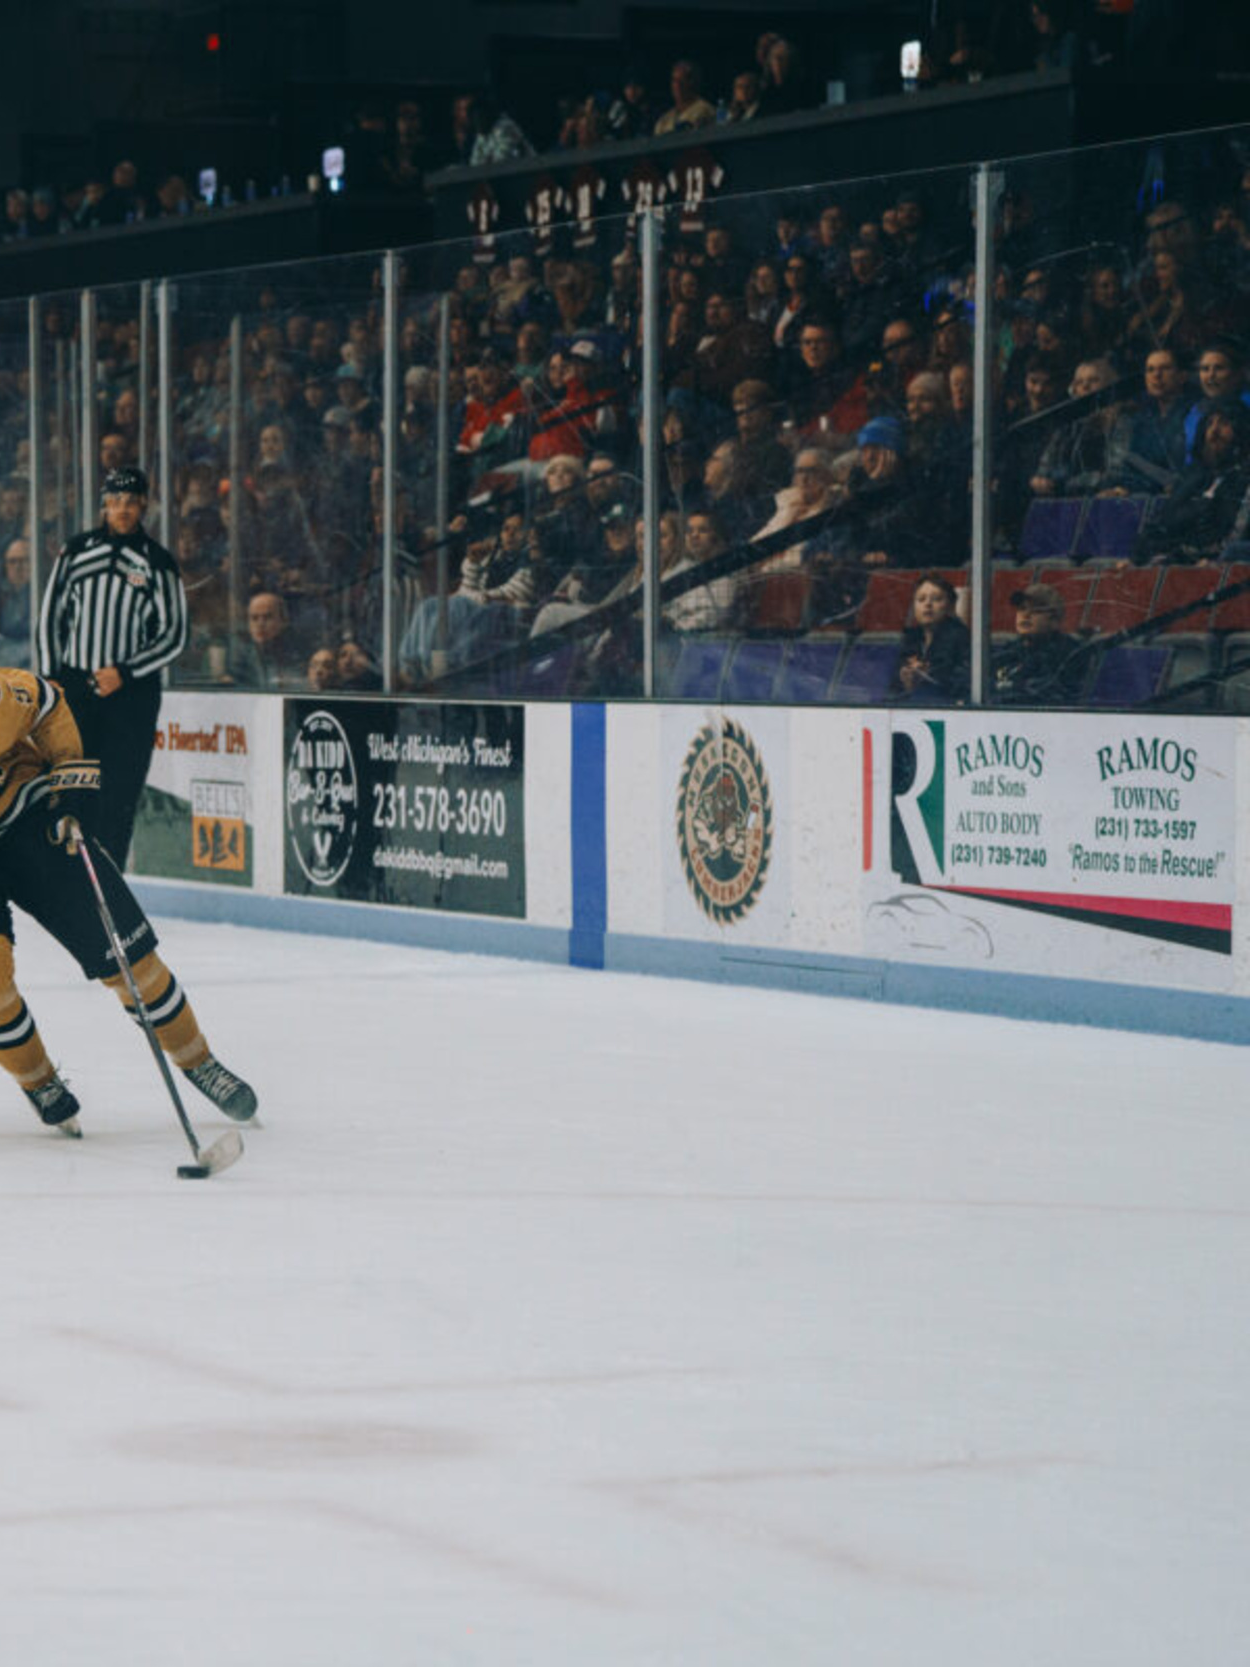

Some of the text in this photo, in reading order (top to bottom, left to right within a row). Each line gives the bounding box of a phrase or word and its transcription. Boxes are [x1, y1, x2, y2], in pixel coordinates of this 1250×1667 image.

[225, 725, 248, 756] IPA
[367, 732, 398, 762] West
[473, 737, 513, 768] Finest
[955, 734, 1045, 779] RAMOS
[1095, 737, 1197, 783] RAMOS
[971, 776, 1027, 798] and Sons
[1111, 787, 1180, 812] TOWING
[372, 782, 507, 838] 231-578-3690
[956, 811, 1042, 837] AUTO BODY
[1095, 818, 1197, 842] (231) 733-1597
[950, 843, 1047, 869] (231) 739-7240
[1123, 853, 1136, 873] to
[1139, 852, 1158, 874] the
